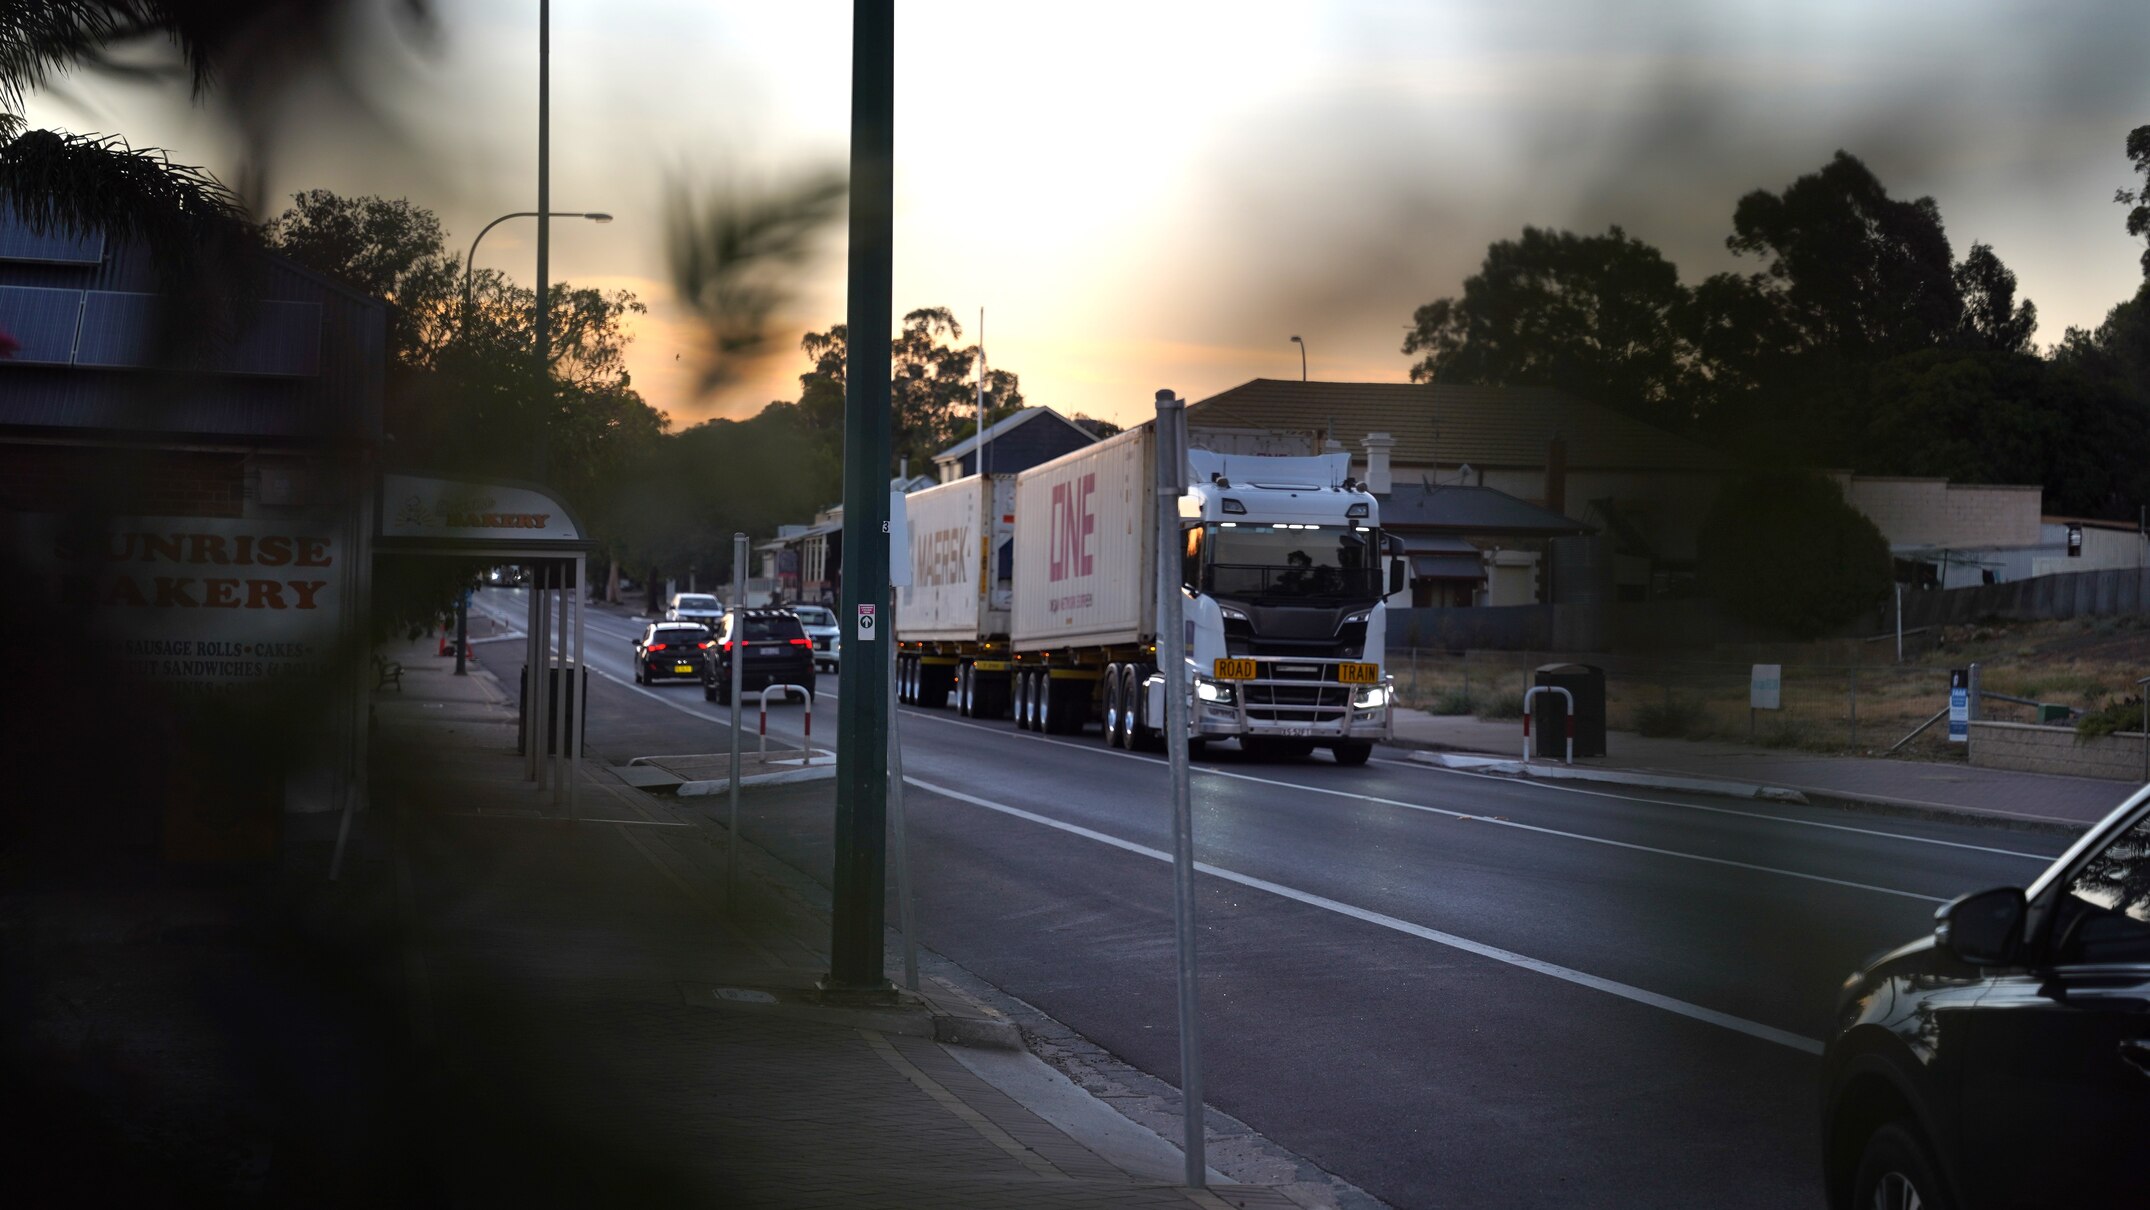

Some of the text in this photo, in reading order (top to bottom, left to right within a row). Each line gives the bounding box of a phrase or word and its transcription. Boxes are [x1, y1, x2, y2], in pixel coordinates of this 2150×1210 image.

[883, 521, 889, 532] 3
[1050, 473, 1095, 582] ONE
[917, 526, 968, 588] MAERSK
[126, 640, 192, 656] SAUSAGE
[163, 660, 263, 677] SANDWICHES
[1219, 660, 1252, 678] ROAD
[1342, 664, 1376, 682] TRAIN
